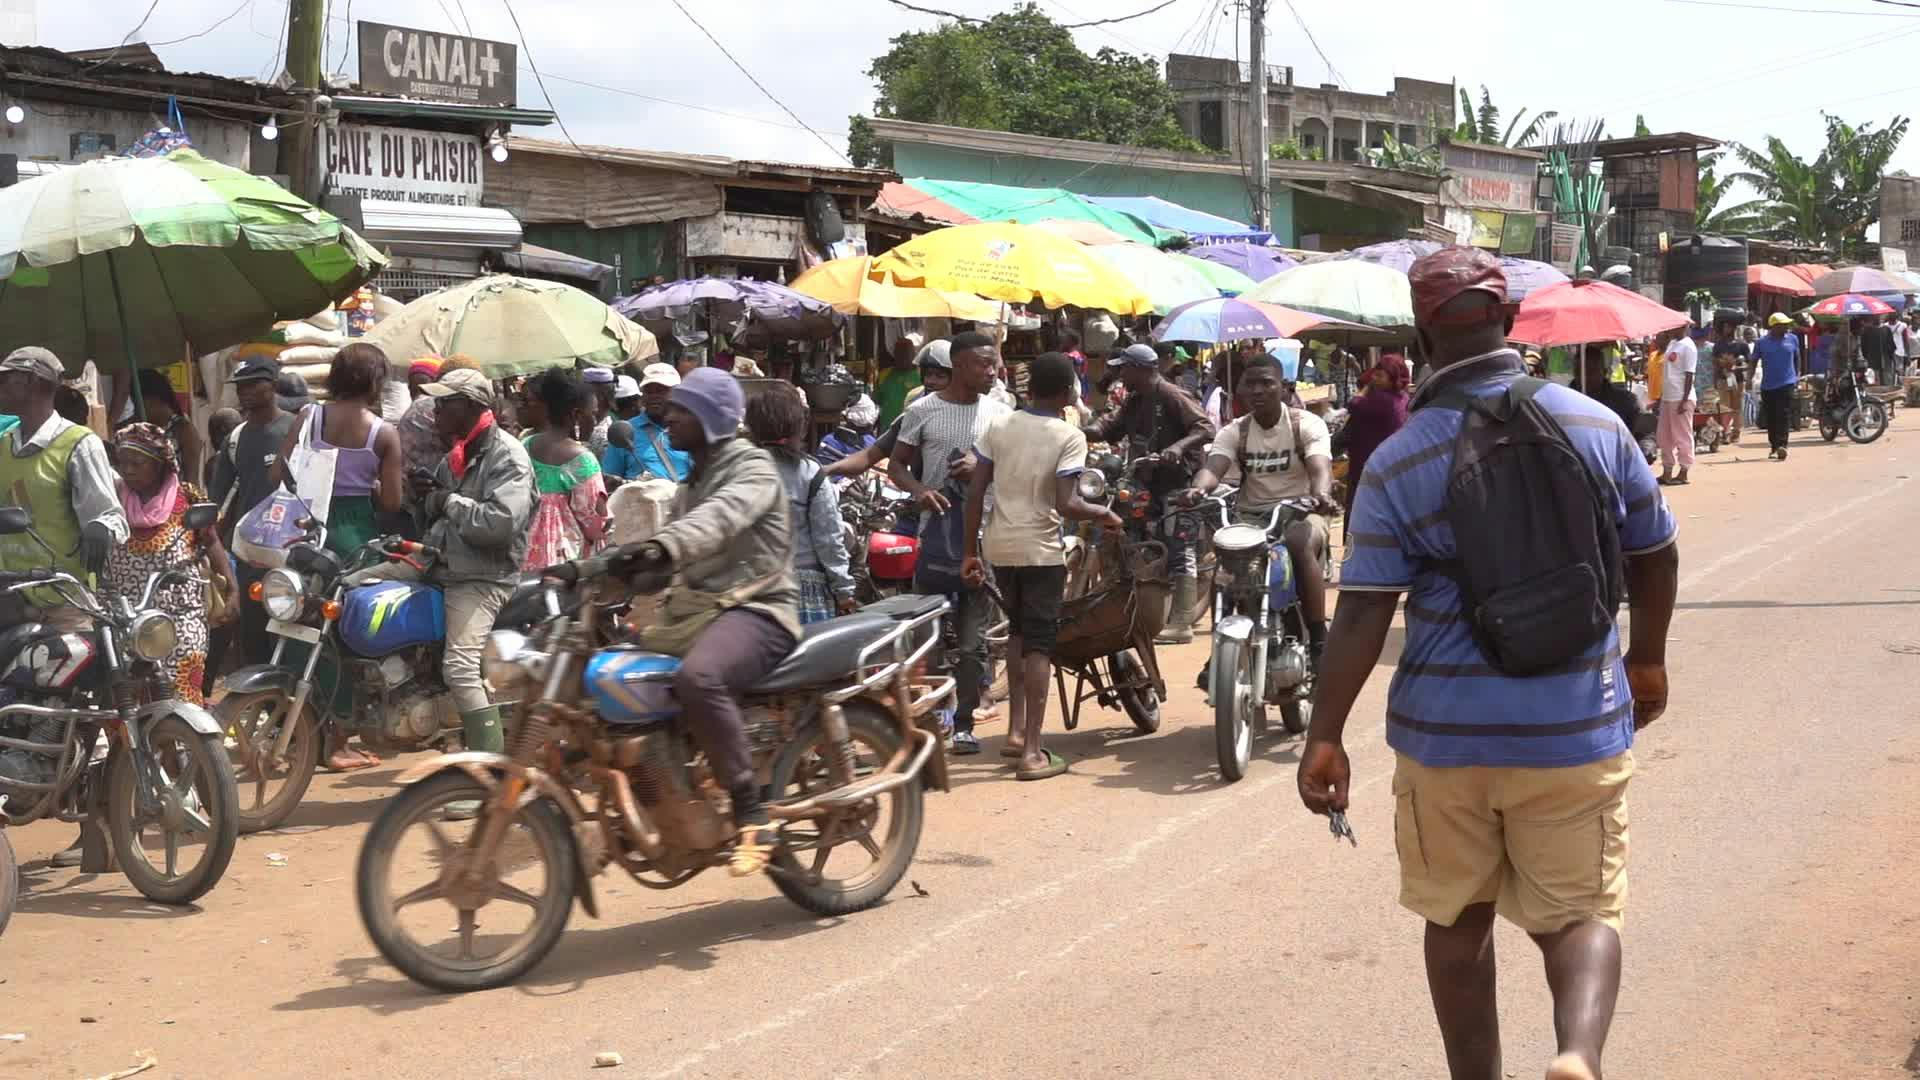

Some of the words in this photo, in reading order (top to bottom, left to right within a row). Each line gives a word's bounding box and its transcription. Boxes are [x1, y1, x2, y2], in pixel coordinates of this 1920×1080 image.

[383, 29, 500, 88] CANAL+
[326, 127, 372, 176] CAVE
[381, 133, 405, 179] DU
[411, 136, 478, 184] PLAISIR
[341, 186, 369, 200] VENTE
[371, 188, 405, 202] PRODUIT
[408, 191, 455, 205] ALIMENTAIRE
[457, 195, 467, 206] ET
